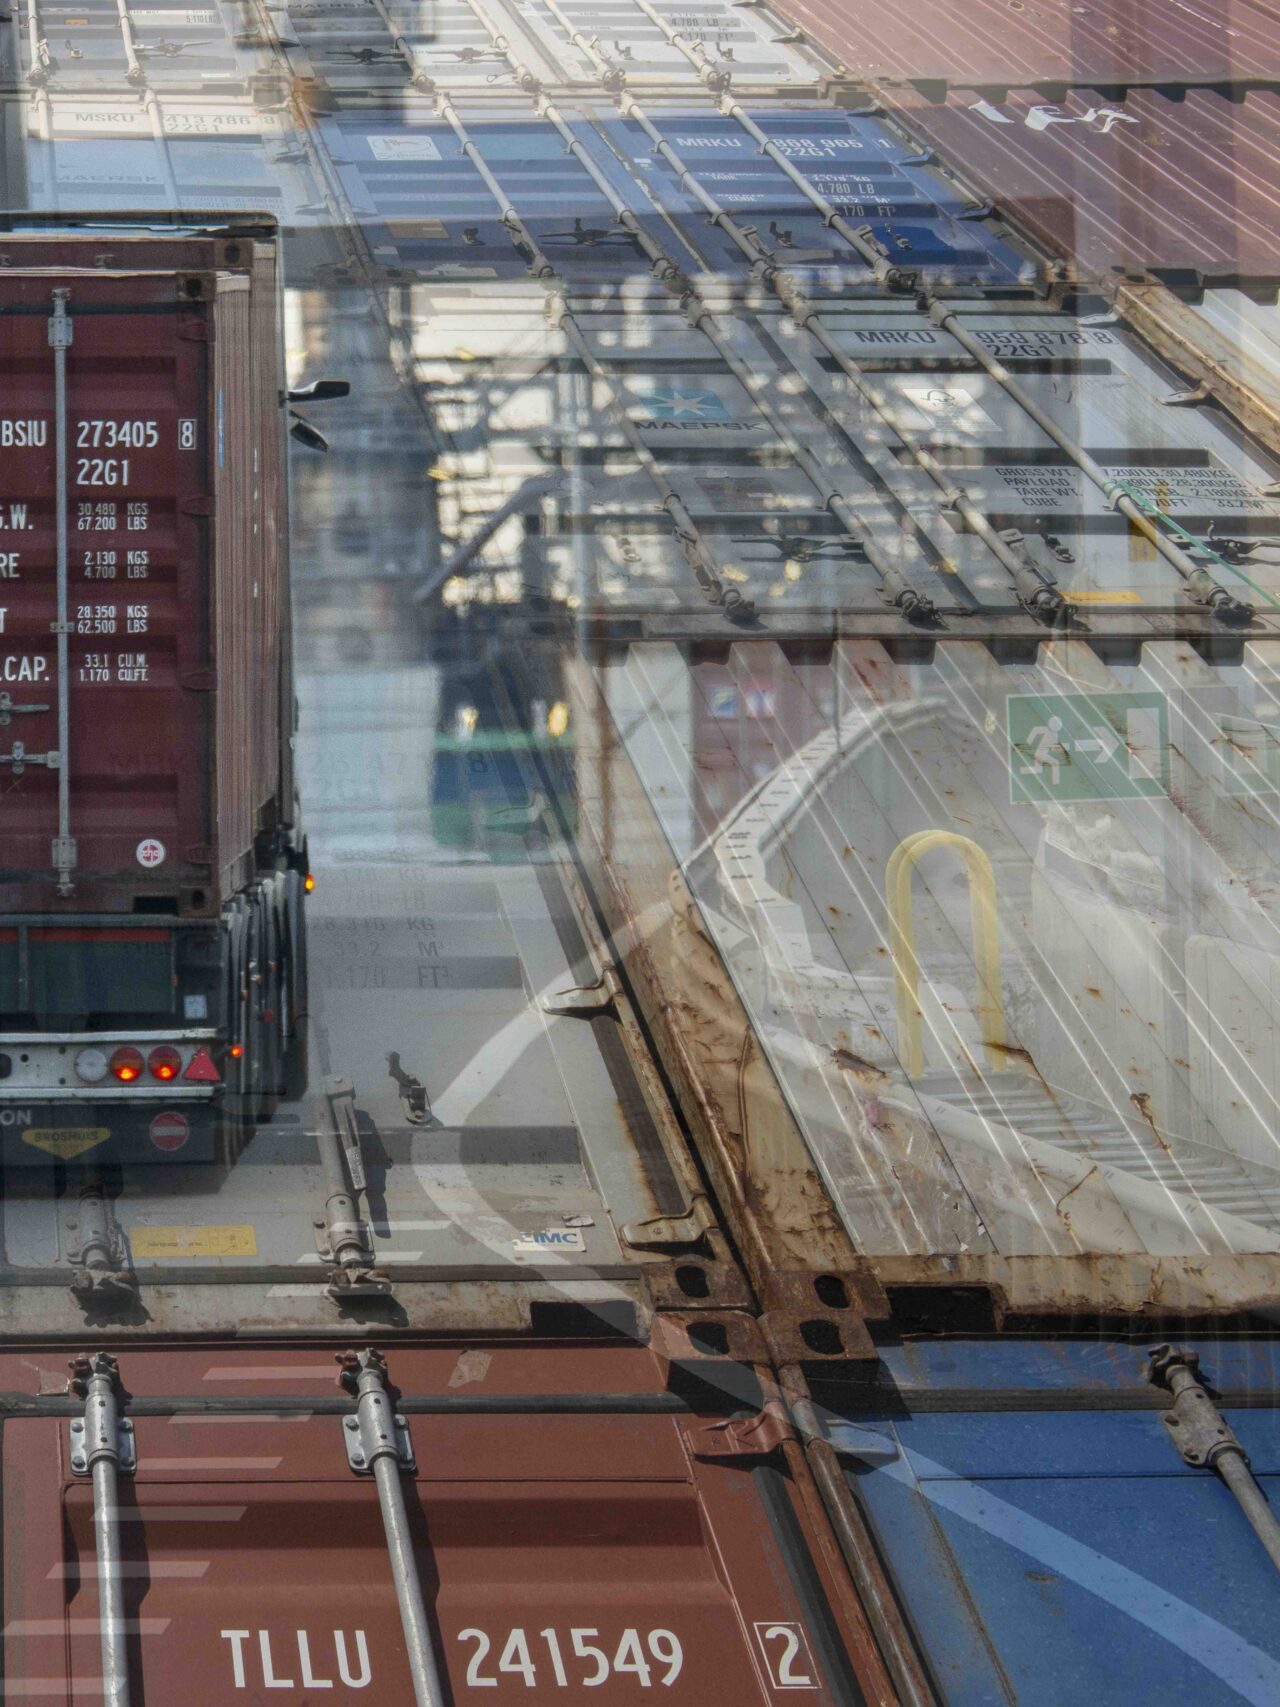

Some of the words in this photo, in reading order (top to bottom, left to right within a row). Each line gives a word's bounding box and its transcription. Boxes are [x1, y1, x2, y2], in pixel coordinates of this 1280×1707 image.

[75, 113, 134, 123] MSKU
[675, 137, 741, 148] MRKU
[821, 138, 864, 149] 965
[780, 147, 837, 157] 22G1
[860, 183, 875, 194] LB
[855, 331, 937, 344] MRKU
[974, 331, 1029, 344] 959
[1034, 332, 1087, 345] 878
[990, 344, 1056, 357] 22G1
[1, 419, 48, 447] BSIU
[76, 420, 159, 448] 273405
[177, 419, 197, 450] 8
[76, 458, 130, 486] 22G1
[994, 467, 1044, 477] GROSS
[1004, 477, 1070, 487] PAYLOAD
[1014, 487, 1057, 497] TARE
[77, 502, 116, 516] 30.480
[127, 502, 149, 516] KGS
[1021, 498, 1065, 508] CUBE
[77, 516, 117, 531] 67.200
[127, 517, 148, 531] LBS
[84, 551, 116, 566] 2.130
[127, 551, 149, 566] KGS
[84, 565, 116, 579] 4.700
[127, 565, 148, 579] LBS
[77, 605, 116, 619] 28.350
[127, 605, 149, 619] KGS
[77, 619, 116, 634] 62.500
[127, 619, 148, 633] LBS
[84, 654, 109, 668] 33.1
[117, 654, 150, 668] CU.M.
[79, 668, 110, 682] 1.170
[33, 1130, 100, 1143] BROSHUIS
[220, 1629, 373, 1689] TLLU
[456, 1627, 685, 1688] 241549
[760, 1624, 816, 1687] 2
